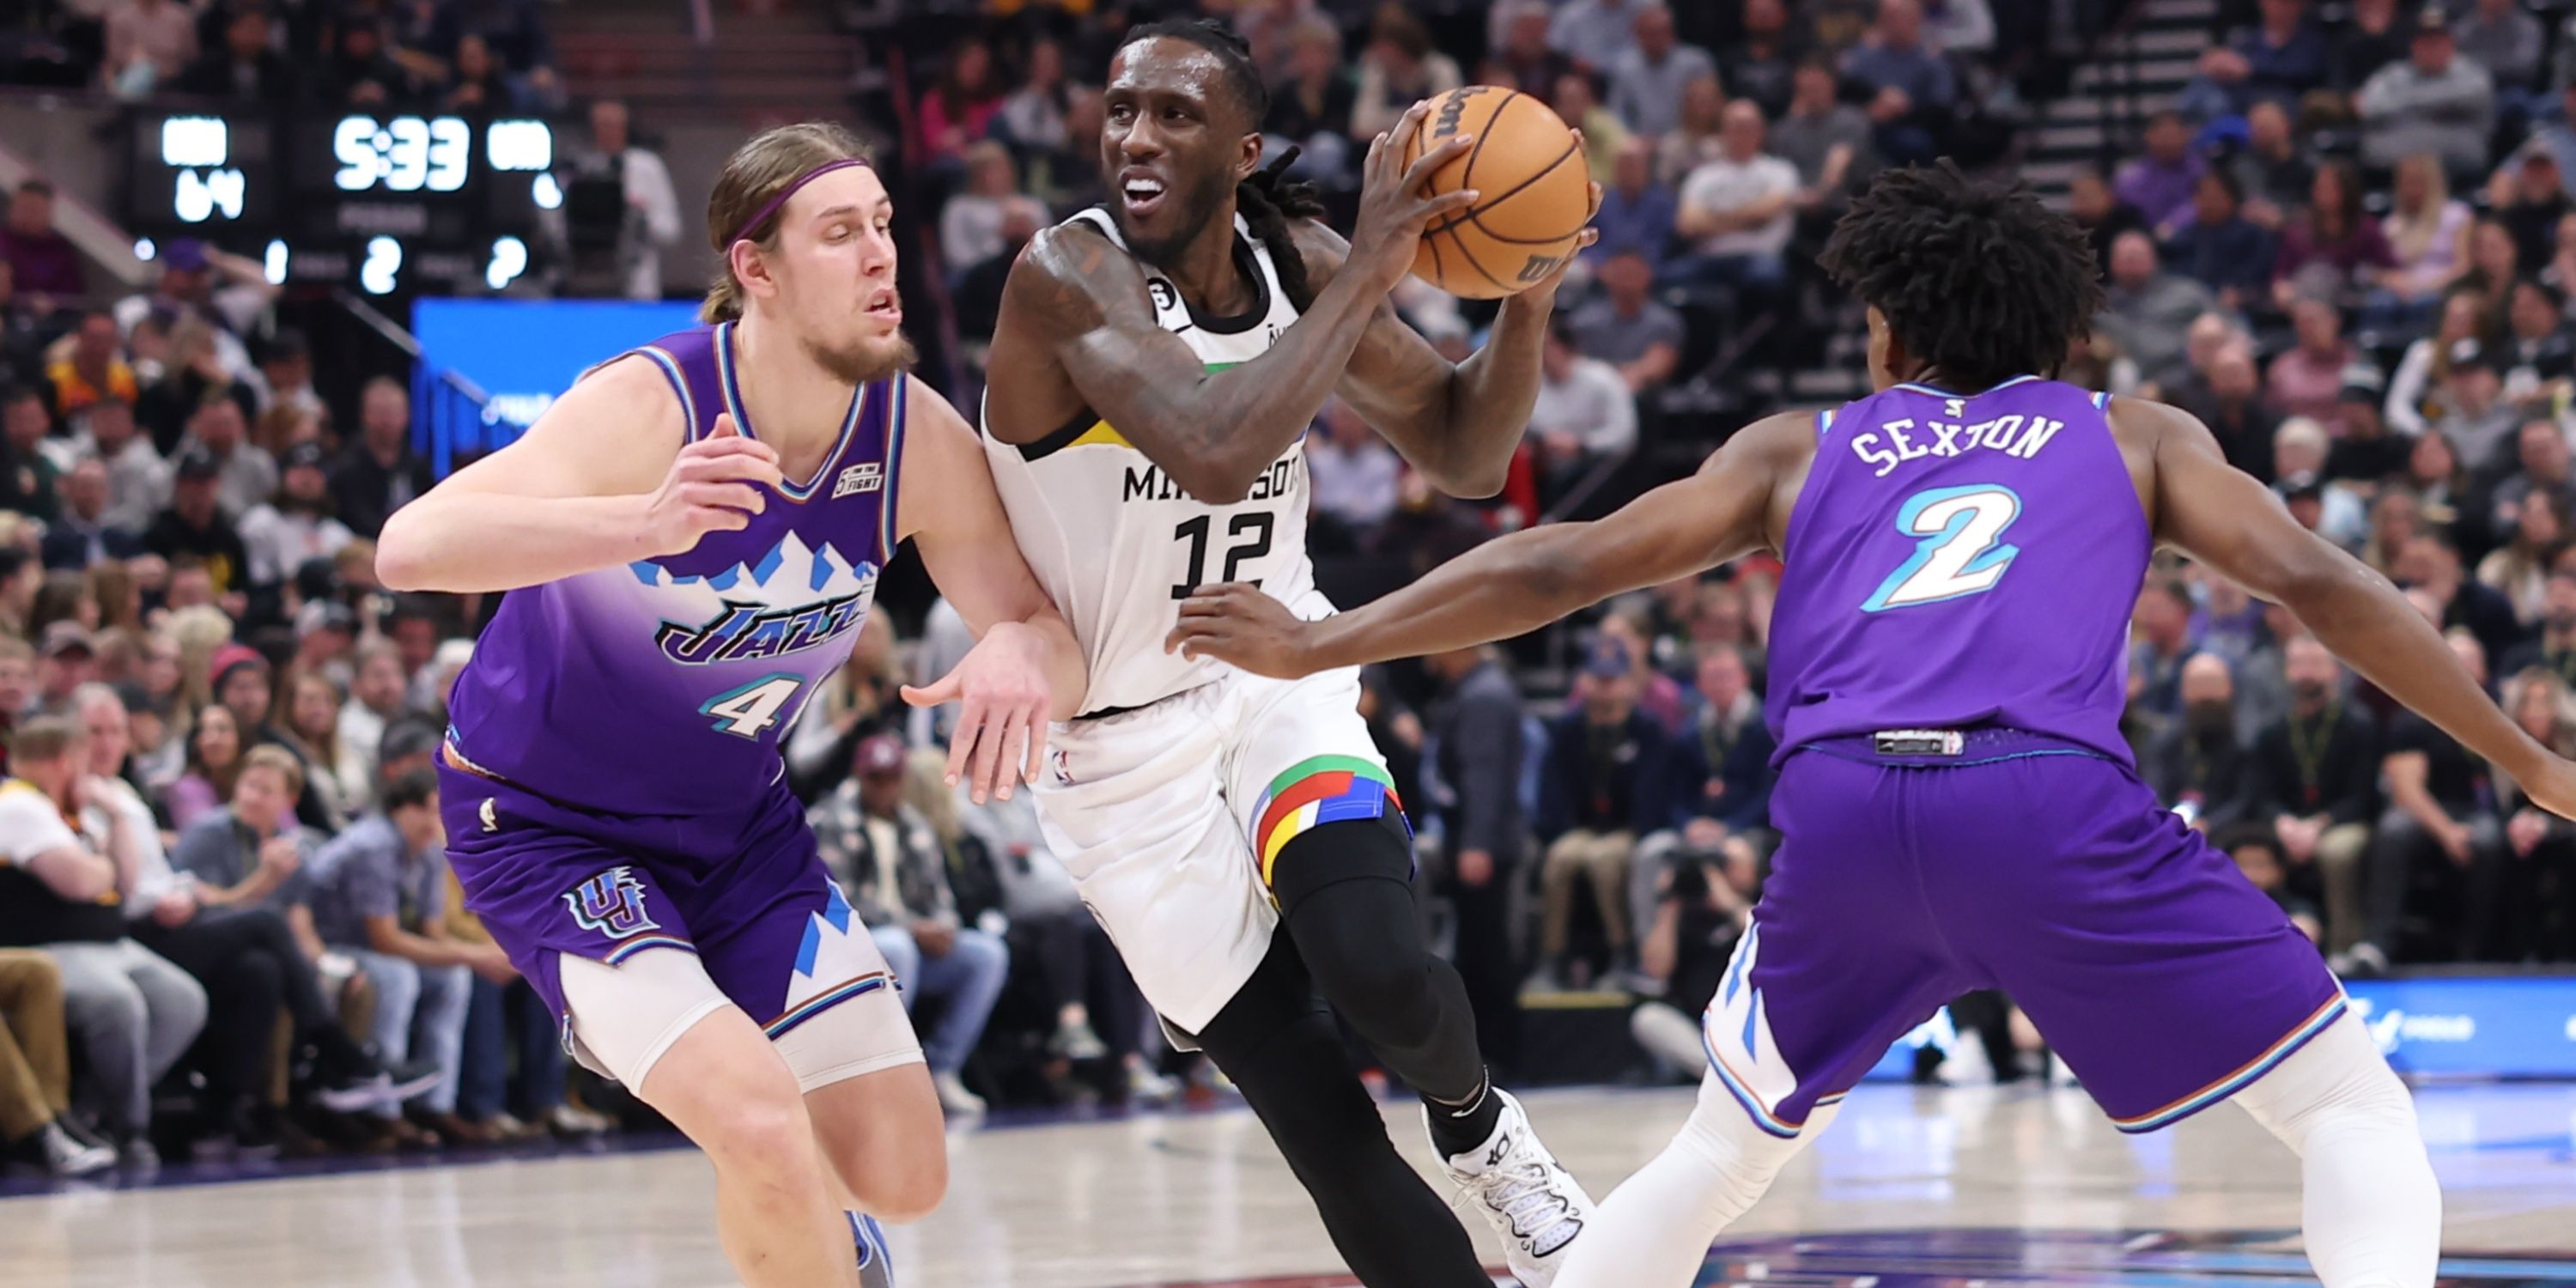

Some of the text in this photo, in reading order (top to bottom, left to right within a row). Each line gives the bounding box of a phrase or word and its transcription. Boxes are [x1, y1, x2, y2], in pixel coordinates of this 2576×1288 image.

[334, 116, 471, 191] 5:33
[174, 168, 245, 222] 64
[361, 235, 402, 295] 2
[1851, 414, 2064, 478] SEXTON
[848, 477, 878, 492] FIGHT
[1171, 512, 1274, 599] 12
[1859, 483, 2023, 613] 2
